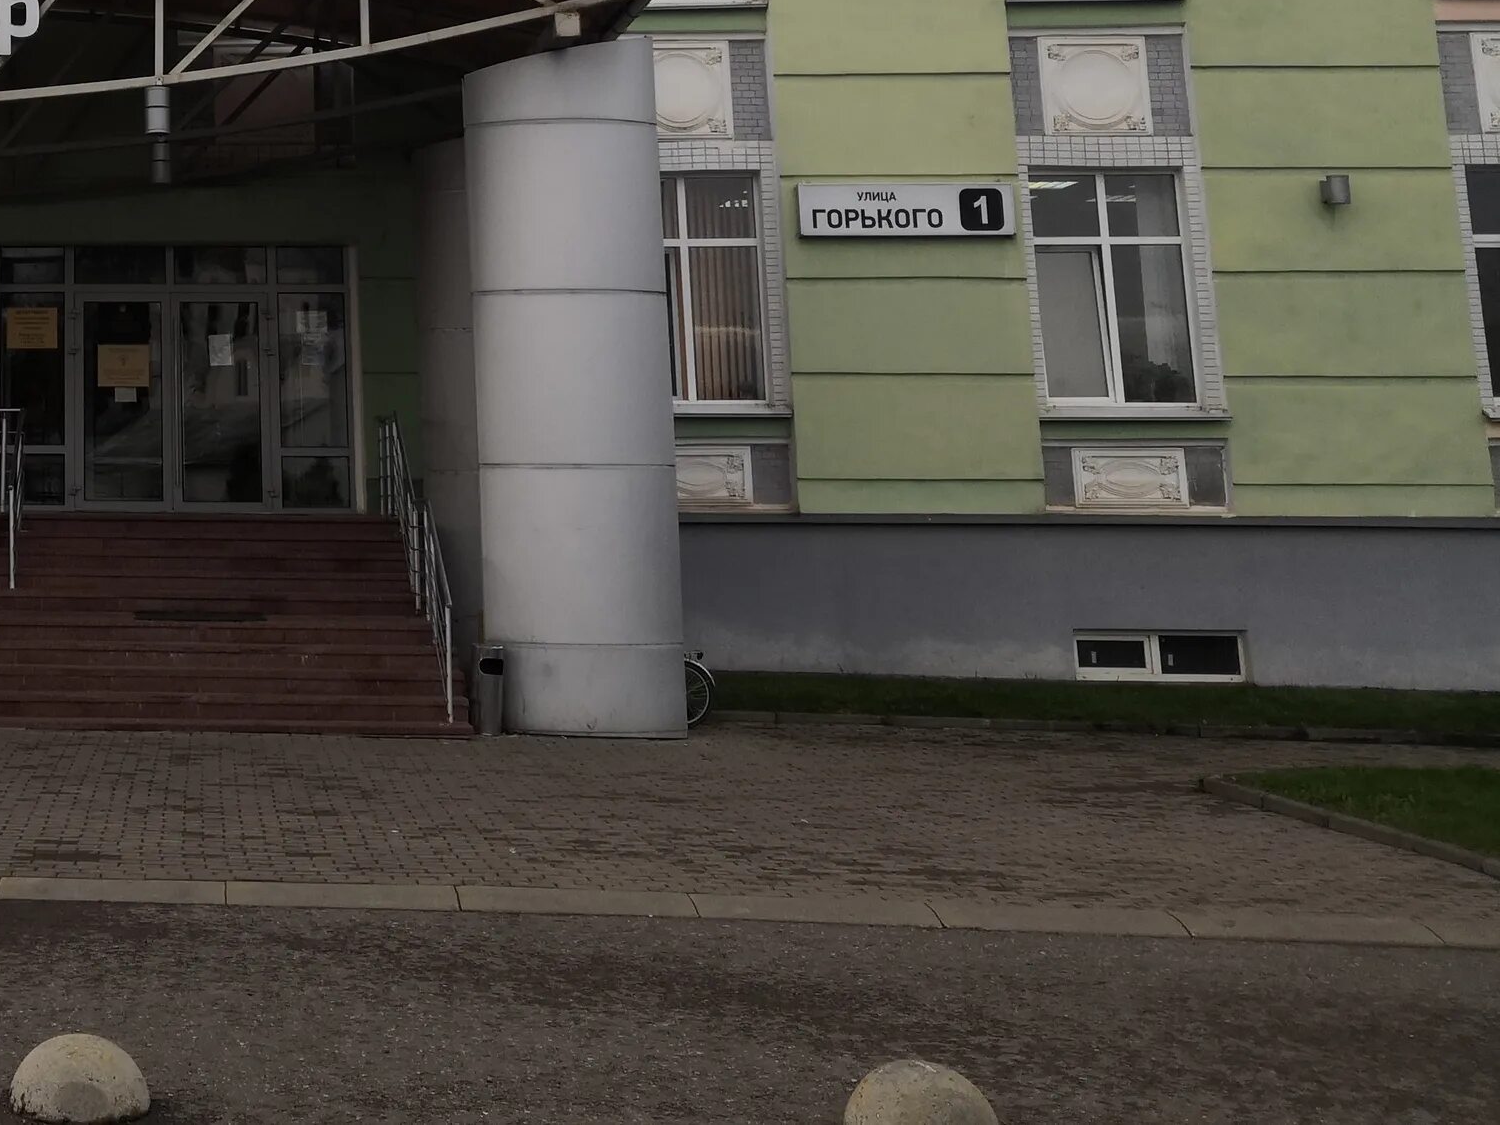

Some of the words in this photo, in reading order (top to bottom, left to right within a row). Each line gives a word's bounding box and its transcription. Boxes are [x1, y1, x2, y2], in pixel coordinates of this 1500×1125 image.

[857, 191, 897, 202] УЛИЦА
[812, 208, 944, 229] ГОРЬКОГО
[973, 195, 989, 225] 1
